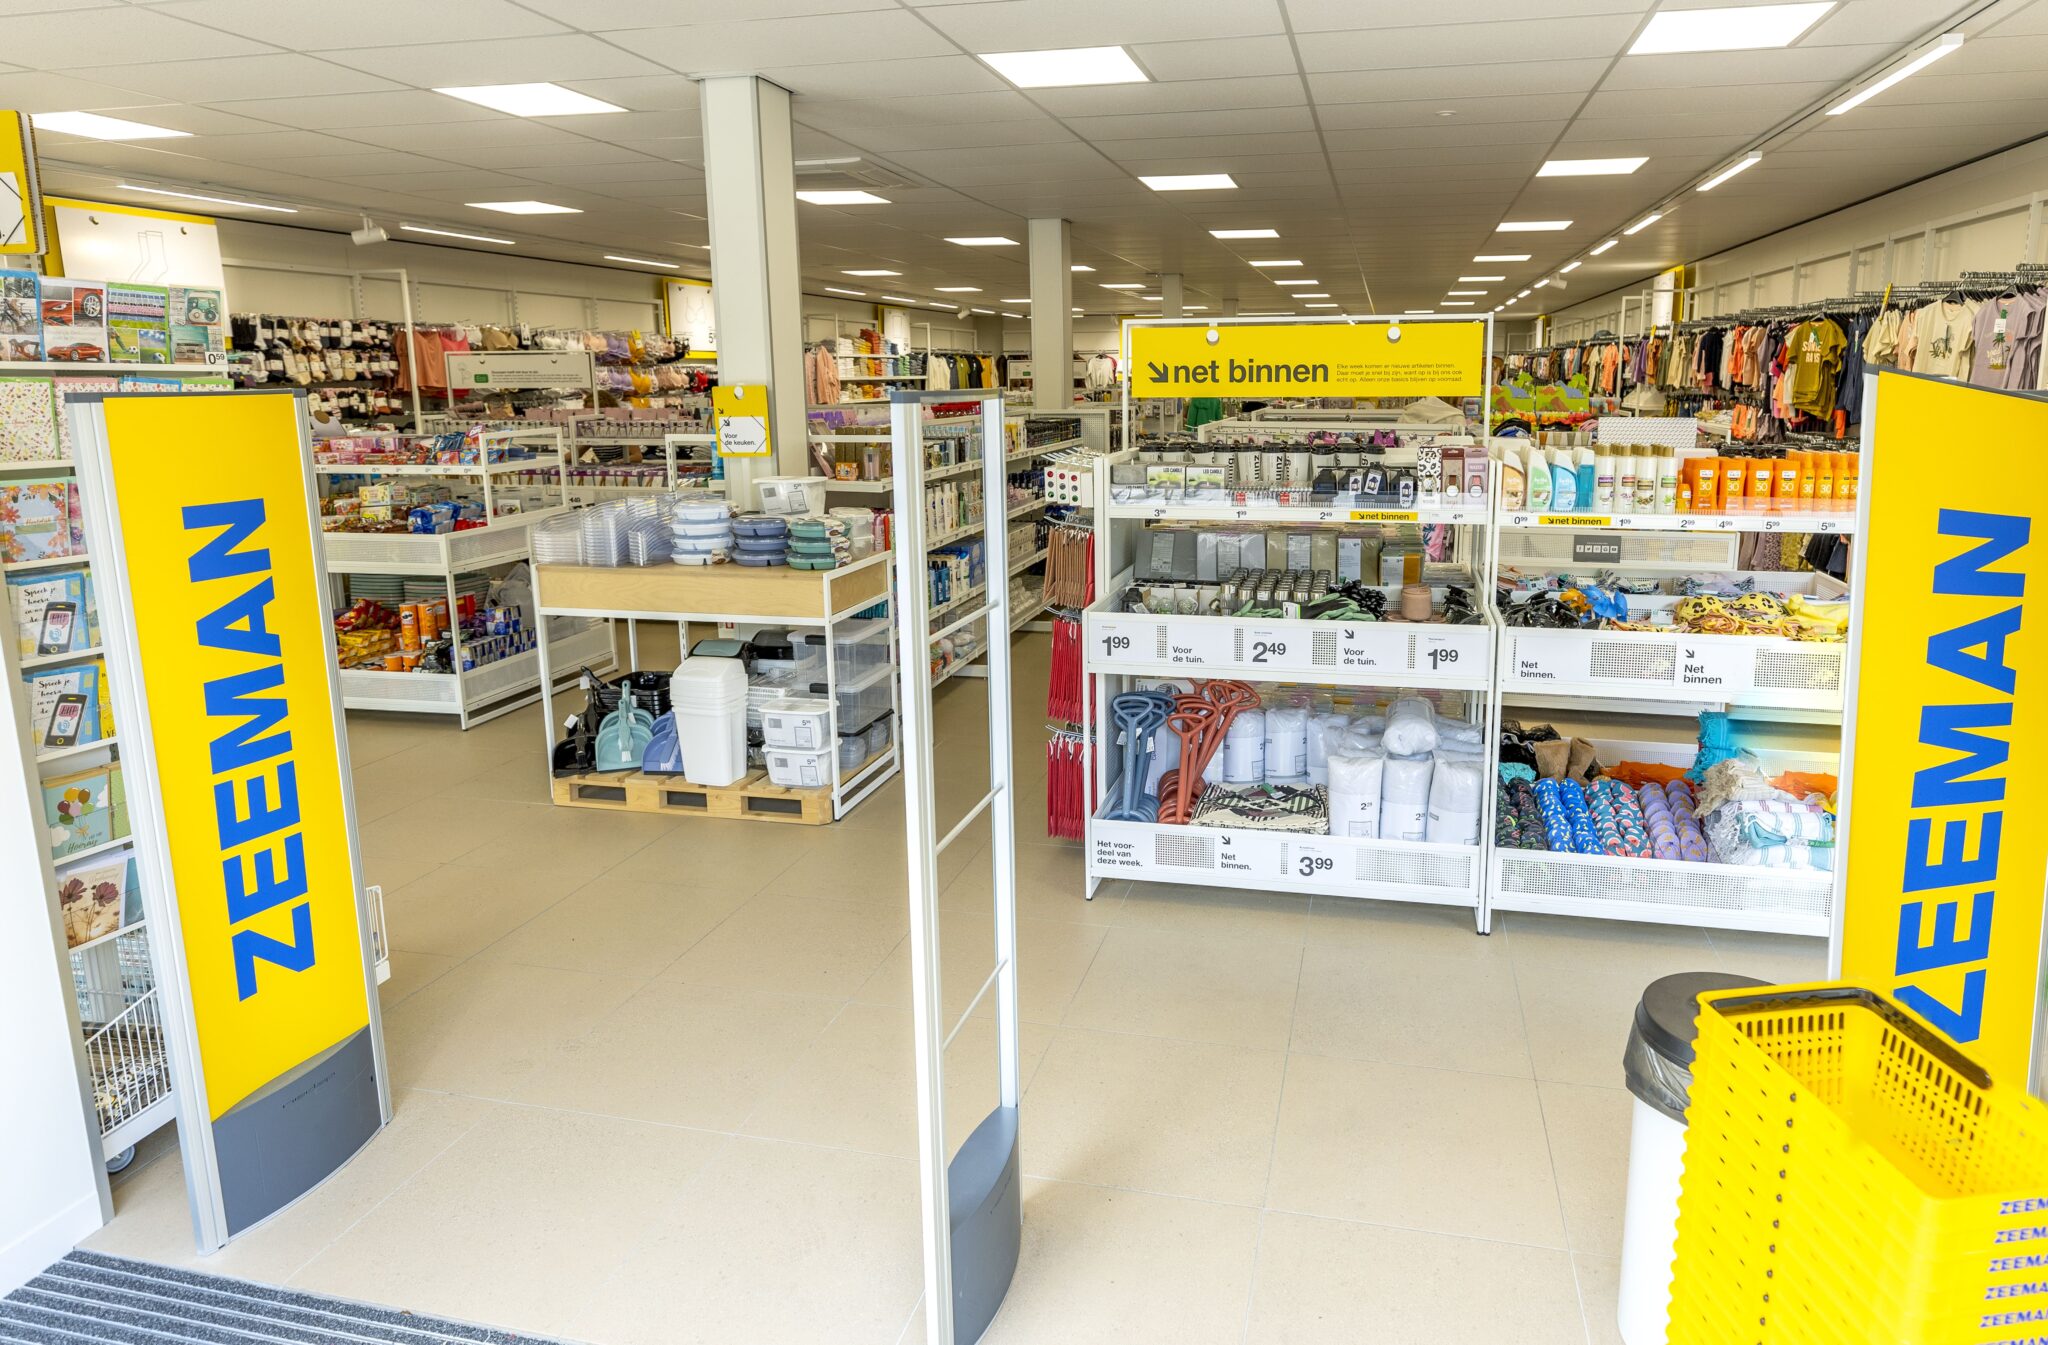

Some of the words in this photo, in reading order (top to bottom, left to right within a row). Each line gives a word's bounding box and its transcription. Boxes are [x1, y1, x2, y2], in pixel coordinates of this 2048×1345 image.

[1173, 360, 1220, 383] net
[1229, 358, 1329, 383] binnen
[1699, 481, 1712, 491] 30
[1727, 481, 1740, 491] 30
[1755, 482, 1769, 492] 50
[1781, 482, 1794, 492] 50
[1154, 509, 1167, 517] 399
[1236, 510, 1247, 518] 199
[1320, 512, 1333, 520] 249
[1381, 512, 1410, 520] binnen
[1513, 516, 1528, 525] 099
[1555, 517, 1570, 525] net
[1571, 516, 1602, 526] binnen
[1680, 520, 1695, 528] 299
[1718, 520, 1733, 529] 499
[1765, 521, 1780, 530] 599
[1820, 522, 1836, 531] 599
[1101, 636, 1130, 656] 199
[1172, 646, 1193, 654] Voor
[1252, 641, 1287, 663] 249
[1343, 648, 1365, 656] Voor
[1172, 655, 1183, 663] de
[1185, 655, 1205, 664] tuin.
[1343, 657, 1355, 665] de
[1357, 657, 1377, 666] tuin.
[1427, 648, 1459, 670] 199
[1521, 660, 1538, 669] Net
[1684, 664, 1704, 674] Net
[1520, 670, 1556, 679] binnen.
[1683, 674, 1722, 685] binnen
[181, 498, 315, 1002] ZEEMAN
[1893, 508, 2032, 1044] ZEEMAN
[1097, 840, 1111, 848] Het
[1113, 841, 1135, 850] voor-
[1097, 848, 1113, 857] deel
[1115, 849, 1132, 858] van
[1221, 853, 1236, 861] Net
[1097, 857, 1119, 866] deze
[1119, 857, 1143, 867] week.
[1220, 861, 1252, 871] binnen.
[1298, 856, 1334, 877] 399
[2000, 1198, 2048, 1214] ZEEM
[1994, 1226, 2048, 1243] ZEEM
[1989, 1254, 2048, 1272] ZEEM
[1985, 1282, 2048, 1300] ZEEMA
[1980, 1309, 2048, 1328] ZEEMA
